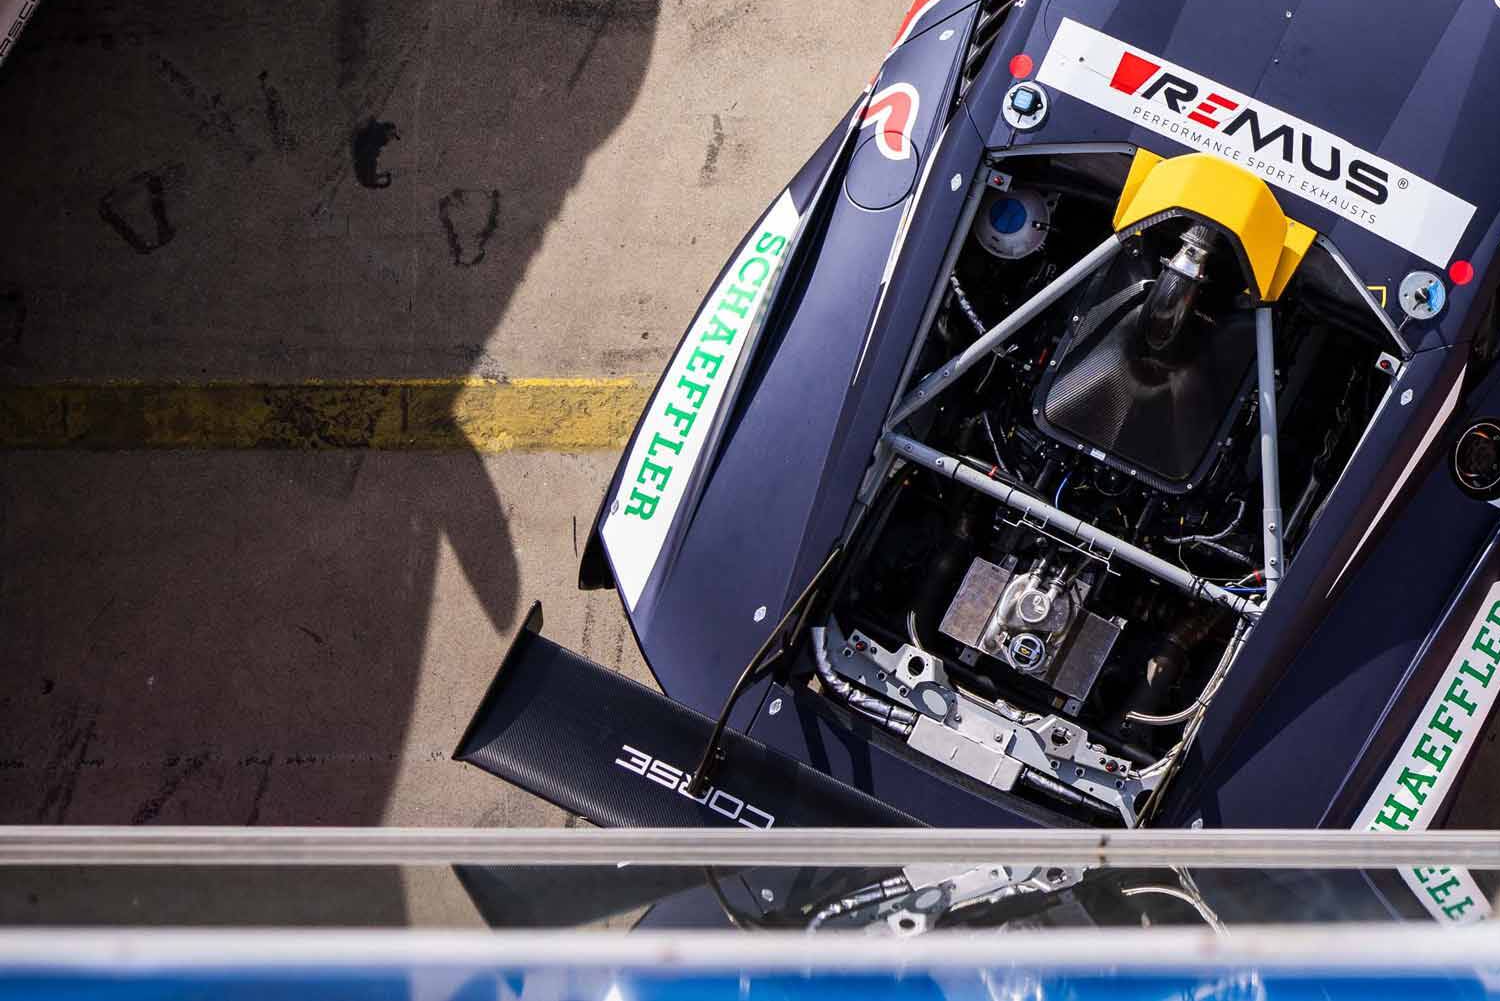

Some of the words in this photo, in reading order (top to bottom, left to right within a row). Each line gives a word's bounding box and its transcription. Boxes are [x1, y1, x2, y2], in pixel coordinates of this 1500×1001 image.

[1132, 105, 1240, 161] PERFORMANCE
[1246, 156, 1295, 185] SPORT
[1299, 180, 1378, 226] EXHAUSTS
[1140, 70, 1391, 206] REMUS
[623, 230, 788, 523] SCHAEFFLER
